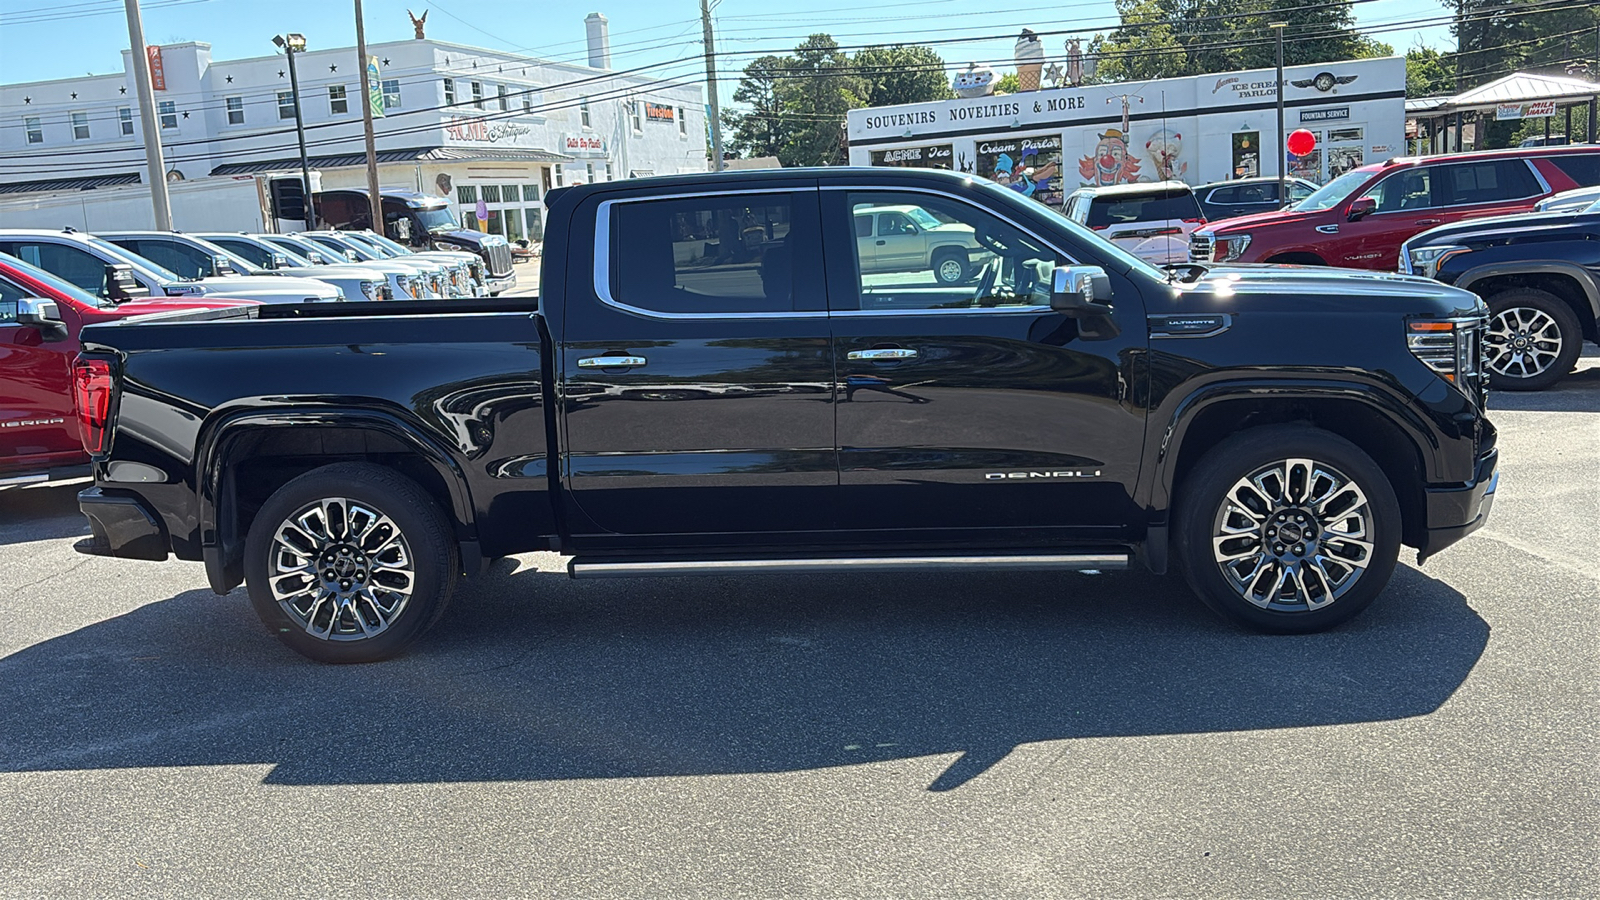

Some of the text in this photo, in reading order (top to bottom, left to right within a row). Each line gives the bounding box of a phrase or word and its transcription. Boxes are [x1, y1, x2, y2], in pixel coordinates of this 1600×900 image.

[1231, 83, 1249, 91] ICE
[1531, 101, 1555, 109] MILK
[866, 96, 1086, 130] SOUVENIRS NOVELTIES & MORE
[1301, 109, 1348, 121] FOUNTAIN SERVICE
[1525, 107, 1554, 117] SHAKES
[446, 115, 489, 142] ACME
[980, 139, 1060, 155] Cream Parlor
[883, 146, 952, 163] ACME Ice
[0, 418, 64, 428] IERRA
[985, 470, 1101, 480] DENALI
